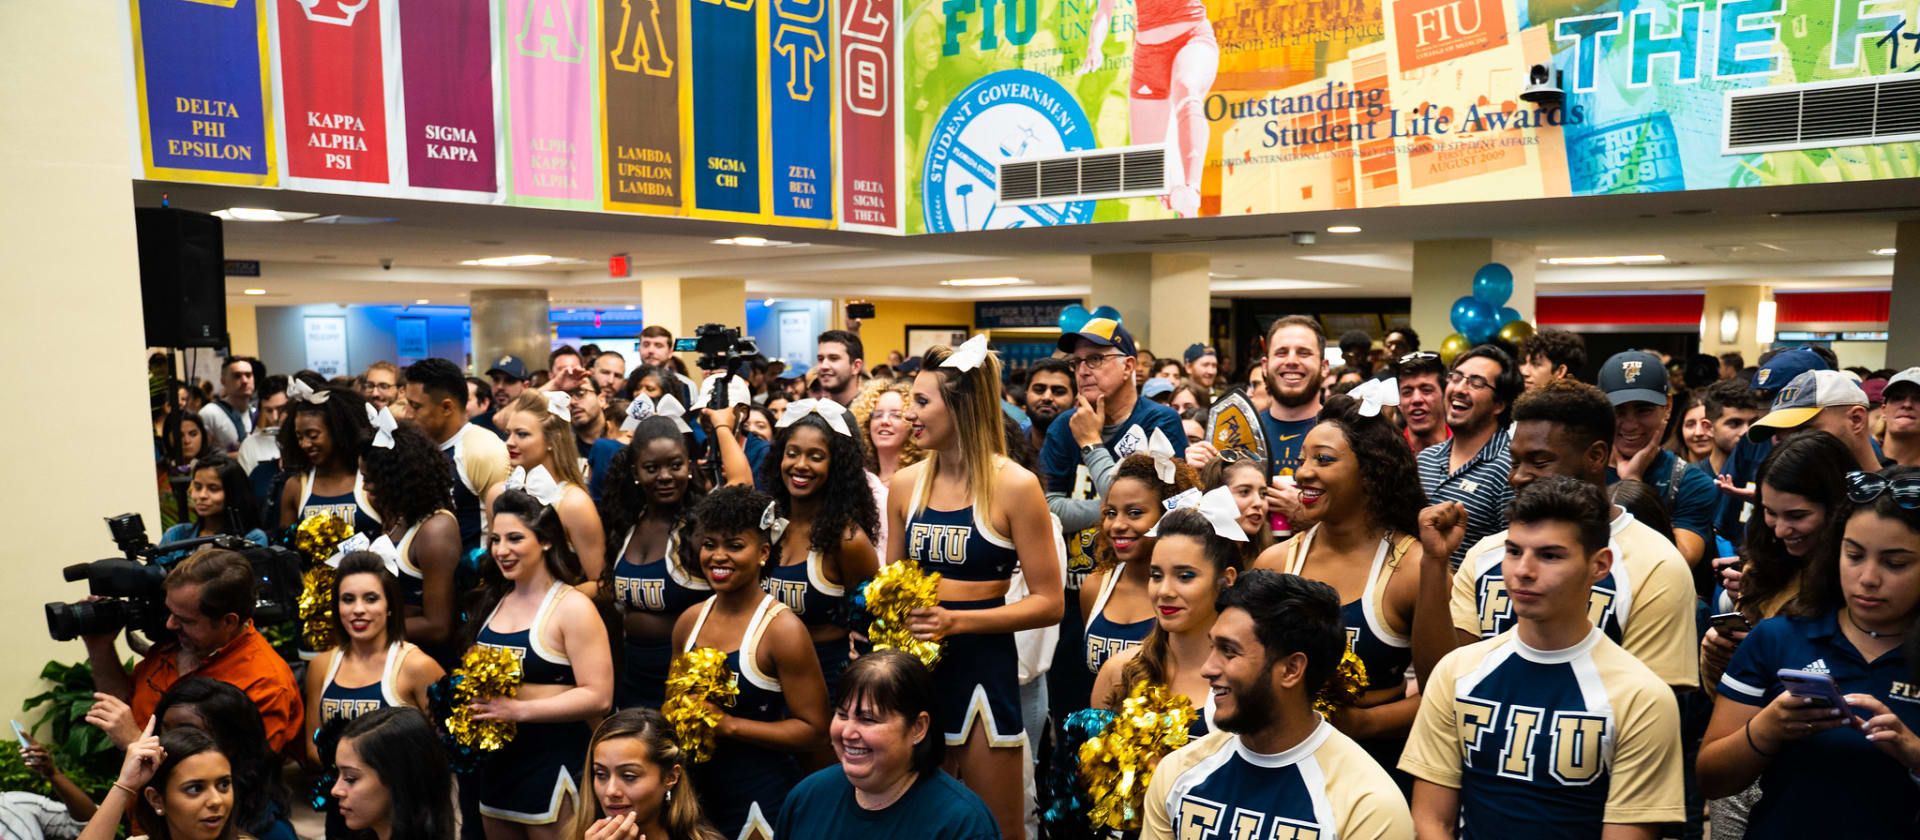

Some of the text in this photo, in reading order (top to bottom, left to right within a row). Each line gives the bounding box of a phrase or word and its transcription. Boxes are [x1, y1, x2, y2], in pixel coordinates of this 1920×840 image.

[942, 0, 1037, 57] FIU
[1412, 0, 1482, 47] FIU
[1554, 0, 1786, 94] THE
[176, 97, 239, 119] DELTA
[1204, 81, 1386, 122] Outstanding
[192, 120, 226, 138] PHI
[308, 111, 366, 131] KAPPA
[1263, 95, 1585, 148] Student Life Awards
[308, 132, 368, 152] ALPHA
[425, 124, 477, 144] SIGMA
[931, 83, 1077, 183] STUDENT GOVERNMENT
[1500, 136, 1541, 148] AFFAIRS
[168, 139, 252, 161] EPSILON
[427, 144, 478, 163] KAPPA
[618, 146, 672, 164] LAMBDA
[325, 153, 352, 170] PSI
[707, 156, 746, 173] SIGMA
[1429, 150, 1506, 175] AUGUST 2009
[618, 163, 672, 180] UPSILON
[716, 173, 738, 188] CHI
[788, 165, 816, 180] ZETA
[619, 180, 673, 197] LAMBDA
[789, 181, 816, 195] BETA
[853, 179, 884, 194] DELTA
[792, 196, 813, 209] TAU
[852, 194, 885, 208] SIGMA
[854, 208, 886, 223] THETA
[909, 523, 972, 564] FIU
[614, 575, 665, 611] FIU
[1455, 695, 1608, 786] FIU
